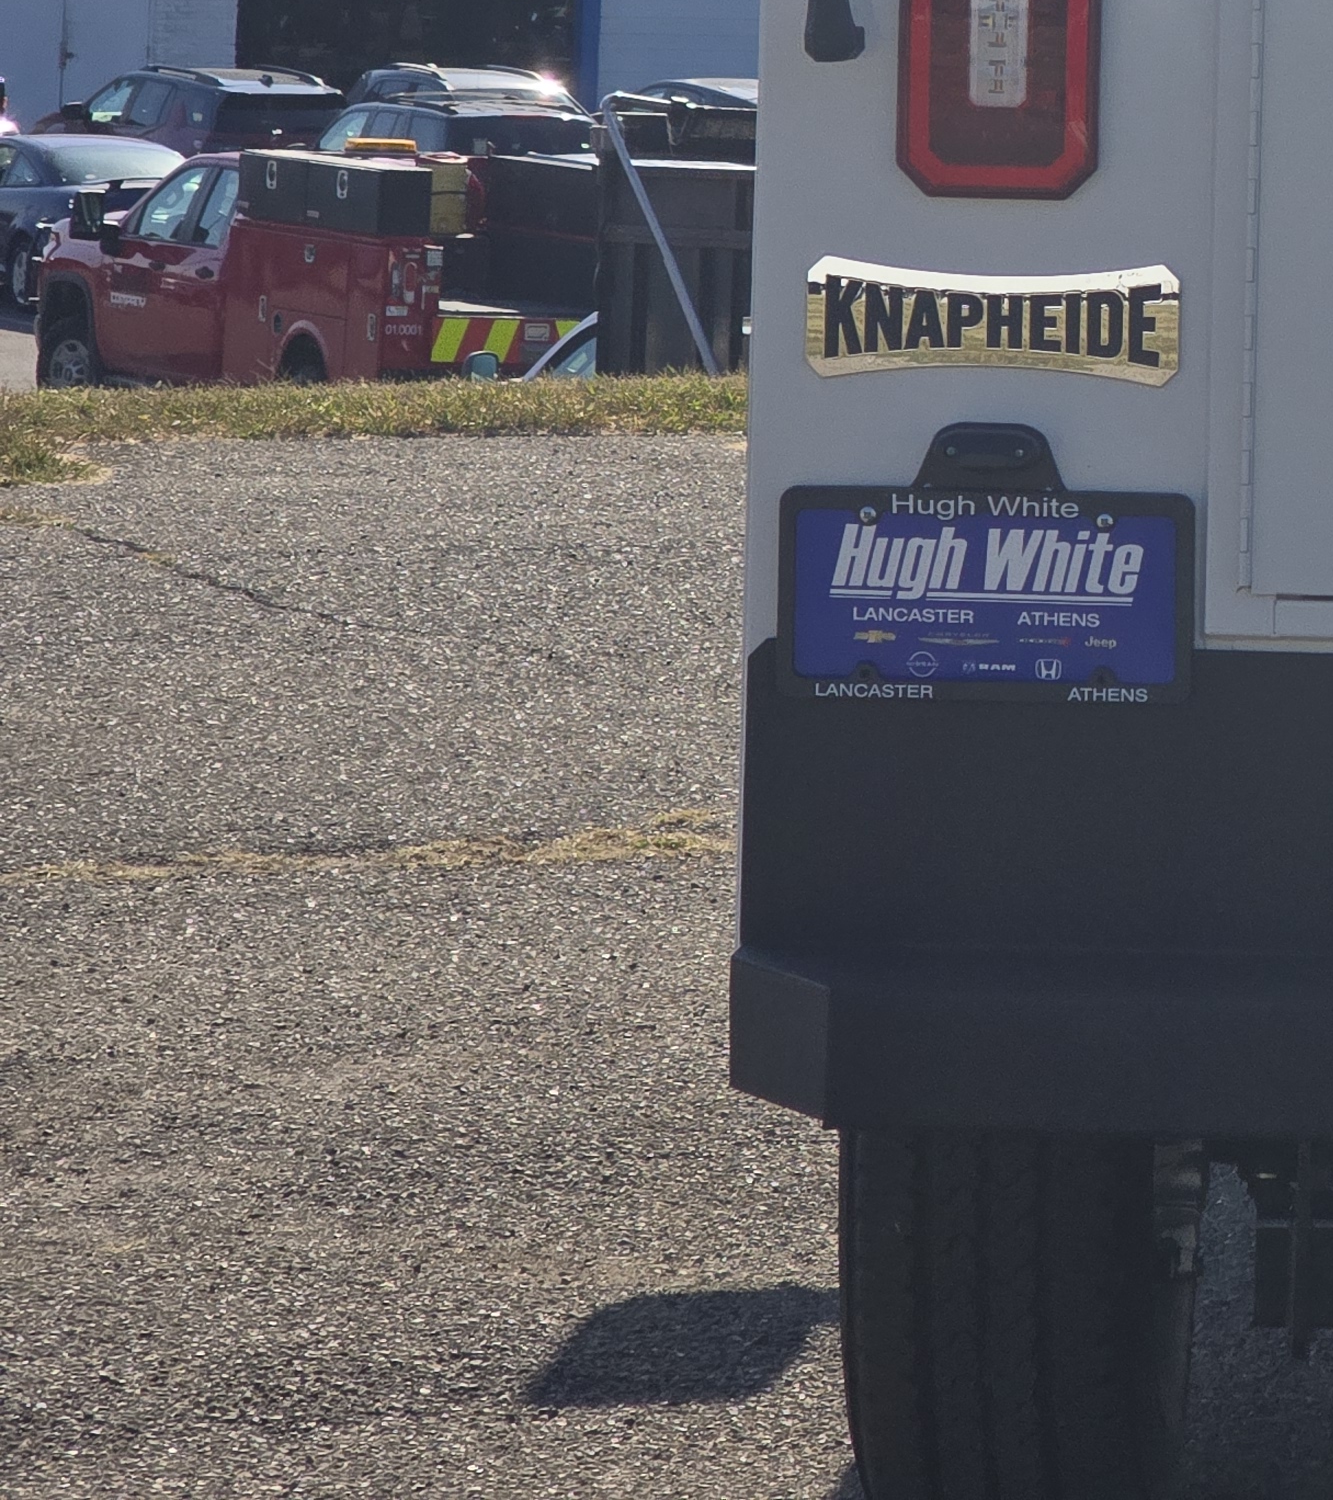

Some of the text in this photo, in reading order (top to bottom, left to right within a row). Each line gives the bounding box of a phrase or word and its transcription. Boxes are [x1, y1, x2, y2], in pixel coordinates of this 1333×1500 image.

[824, 274, 1162, 368] KNAPHEIDE
[891, 493, 1079, 521] Hugh White
[831, 523, 1144, 600] Hugh White
[852, 606, 1100, 628] LANCASTER ATHENS
[1084, 636, 1117, 649] Jeep
[979, 663, 1016, 671] RAM
[815, 683, 1148, 703] LANCASTER ATHENS
